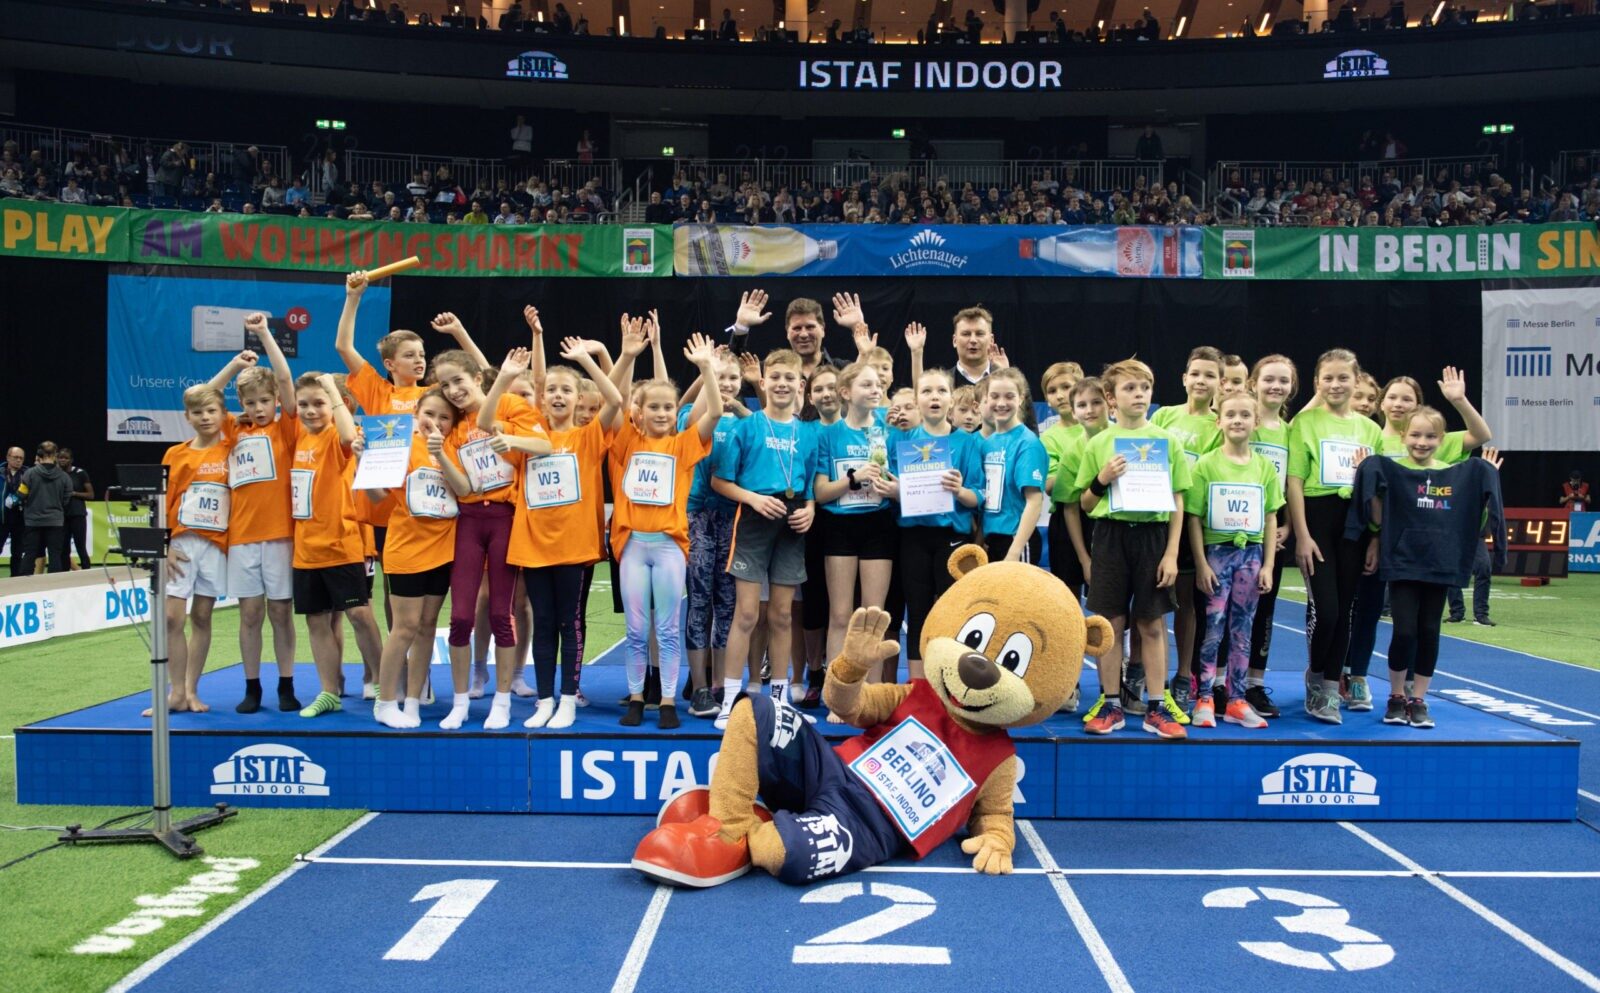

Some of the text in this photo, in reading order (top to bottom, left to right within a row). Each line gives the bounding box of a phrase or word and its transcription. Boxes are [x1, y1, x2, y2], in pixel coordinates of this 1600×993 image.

[1336, 56, 1376, 70] ISTAF
[800, 60, 1063, 88] ISTAF INDOOR
[3, 209, 115, 254] PLAY
[140, 219, 584, 272] AM WOHNUNGSMARKT
[1319, 234, 1359, 272] IN
[1374, 232, 1521, 273] BERLIN
[889, 248, 968, 269] Lichtenauer
[289, 314, 308, 324] 0 €
[1523, 319, 1576, 328] Messe Berlin
[1566, 353, 1600, 376] M
[130, 375, 175, 389] Unsere
[1521, 398, 1574, 406] Messe Berlin
[367, 438, 406, 449] URKUNDE
[236, 452, 254, 467] M4
[474, 453, 498, 470] W1
[903, 461, 946, 473] URKUNDE
[1126, 462, 1163, 472] RKUNDE
[537, 471, 560, 486] W3
[637, 468, 658, 483] W4
[426, 484, 447, 499] W2
[1417, 480, 1453, 496] KIEKE
[199, 496, 219, 511] M3
[1227, 499, 1249, 513] W2
[105, 587, 149, 621] DKB
[0, 601, 41, 638] KB
[233, 755, 305, 783] ISTAF
[560, 750, 721, 800] ISTA
[881, 747, 936, 808] BERLINO
[1282, 765, 1356, 792] ISTAF
[233, 784, 305, 794] INDOOR
[875, 771, 920, 825] ISTAF_INDOOR
[1282, 794, 1355, 804] INDOOR
[382, 879, 499, 961] 1
[792, 882, 952, 965] 2
[1202, 886, 1396, 971] 3
